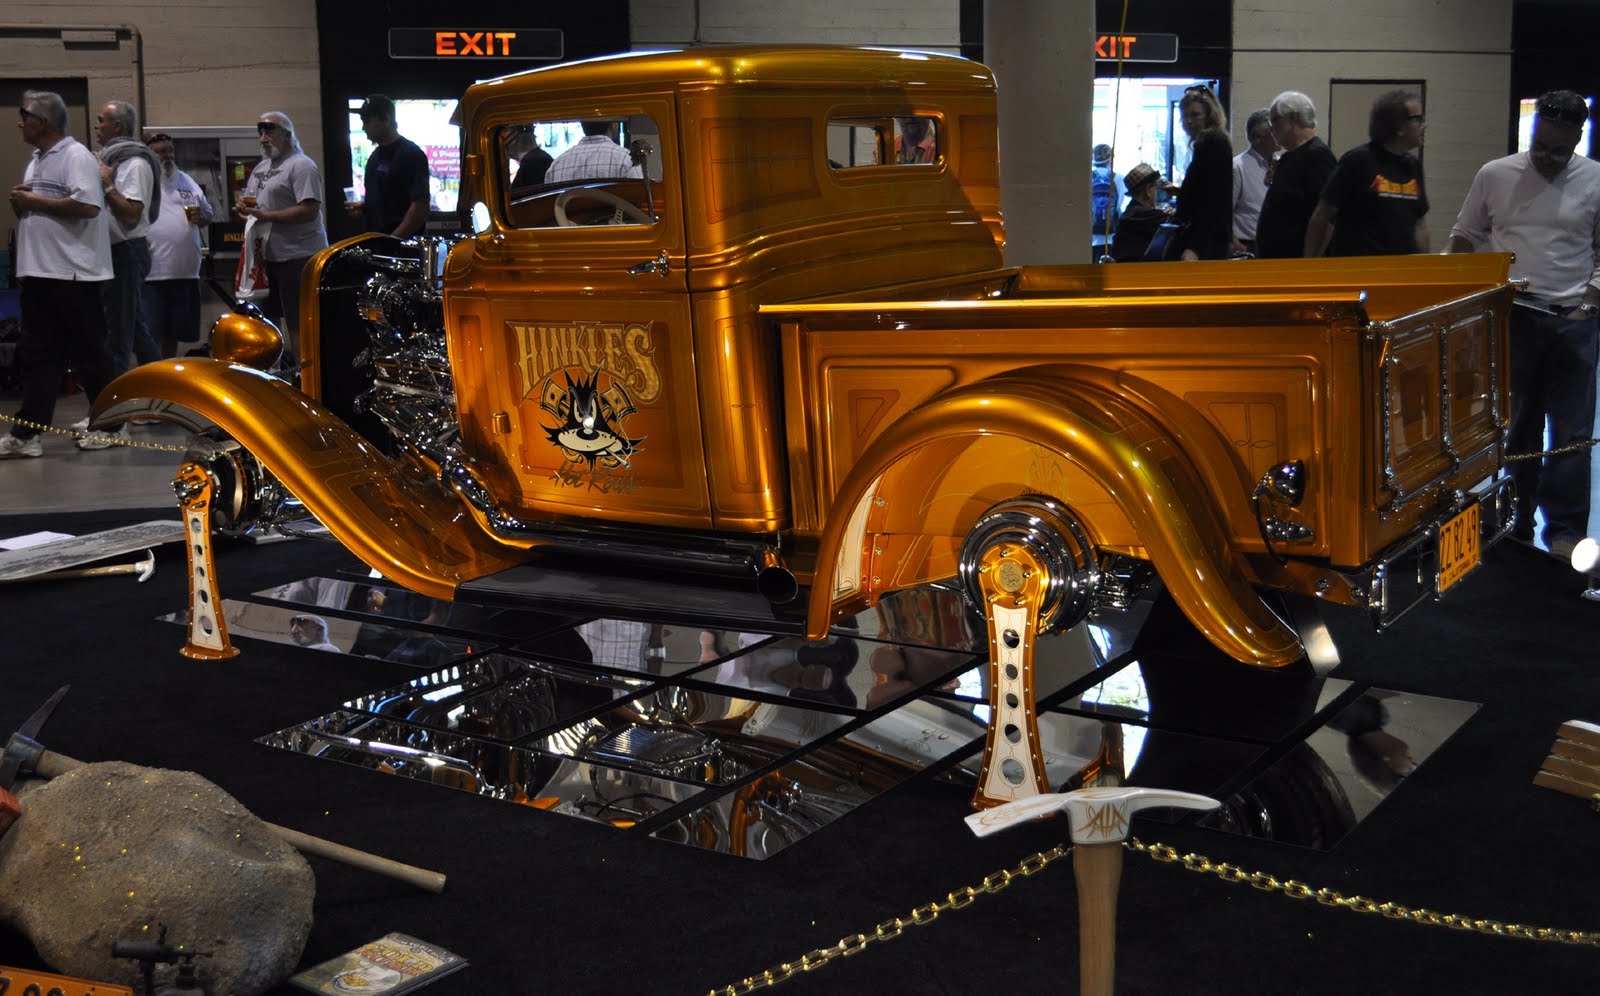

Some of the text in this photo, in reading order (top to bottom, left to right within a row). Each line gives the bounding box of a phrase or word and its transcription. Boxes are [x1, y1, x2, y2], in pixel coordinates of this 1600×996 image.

[436, 32, 516, 55] EXIT
[549, 461, 586, 489] Hot
[1454, 517, 1464, 562] 82
[1467, 509, 1477, 552] 49
